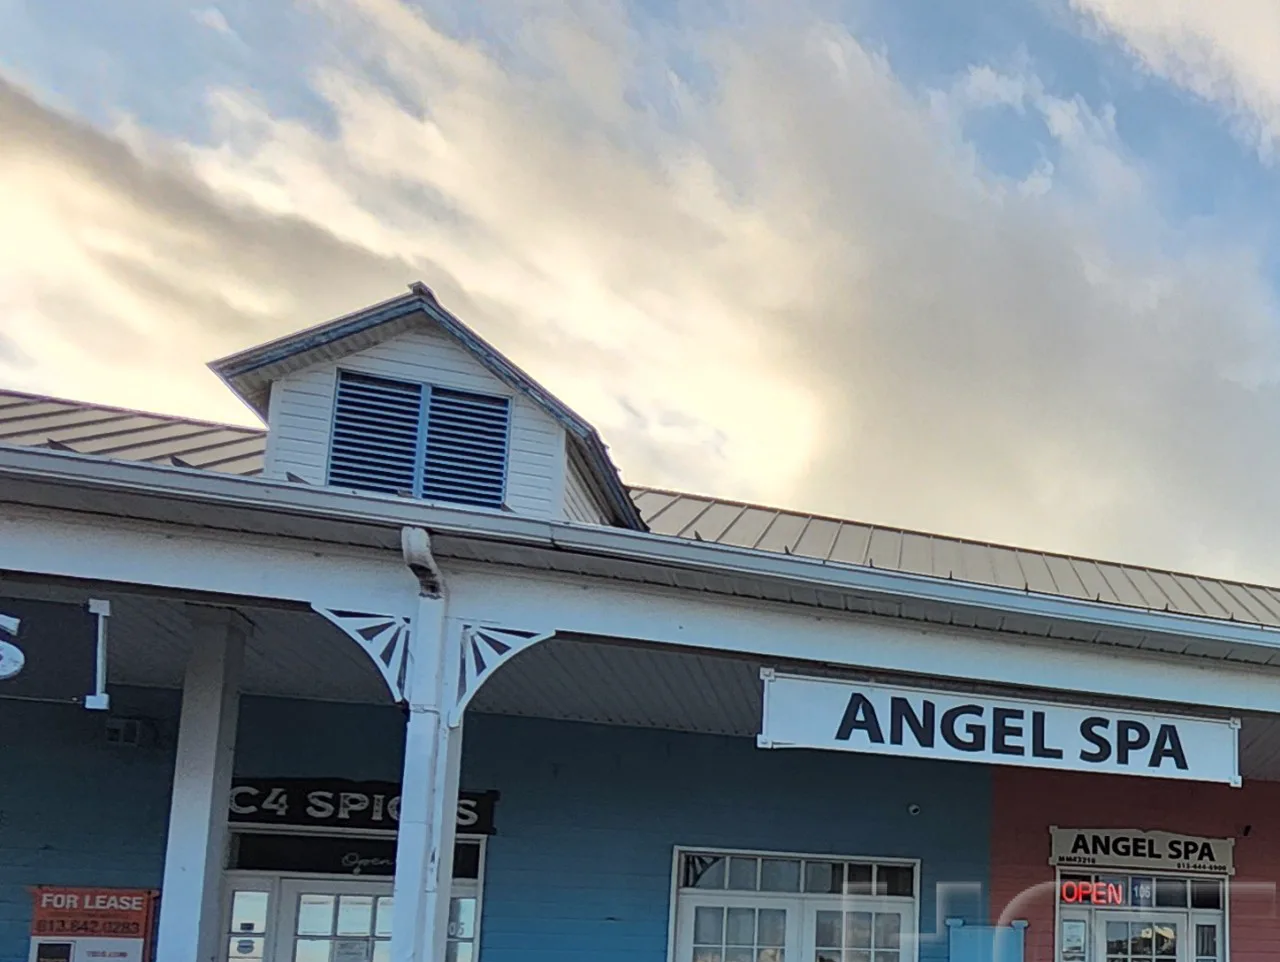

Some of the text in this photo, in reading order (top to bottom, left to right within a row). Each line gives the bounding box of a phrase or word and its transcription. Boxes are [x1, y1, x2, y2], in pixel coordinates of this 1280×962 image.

[835, 692, 1189, 771] ANGEL SPA
[228, 786, 480, 827] C4 SPICS
[1071, 834, 1216, 862] ANGEL SPA
[41, 893, 143, 911] FOR LEASE
[1061, 881, 1123, 905] OPEN
[1132, 884, 1151, 899] 106
